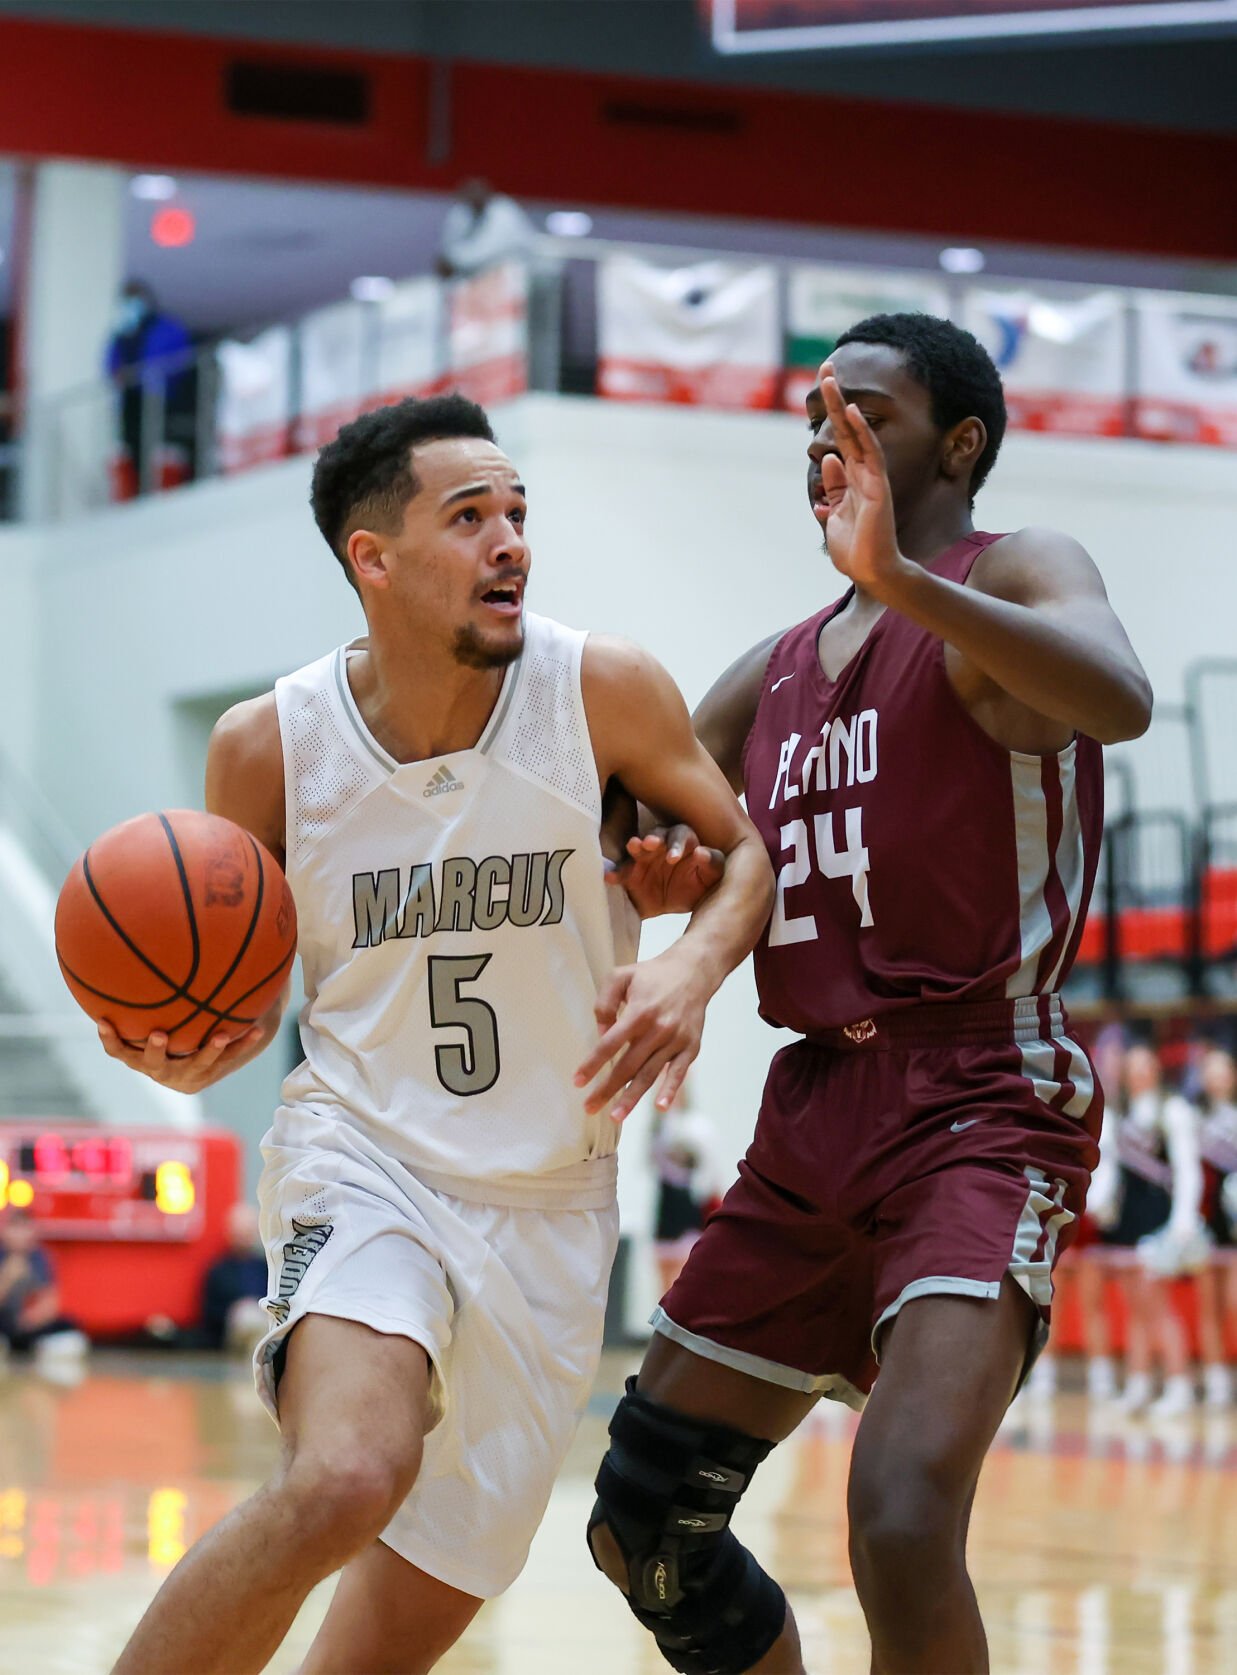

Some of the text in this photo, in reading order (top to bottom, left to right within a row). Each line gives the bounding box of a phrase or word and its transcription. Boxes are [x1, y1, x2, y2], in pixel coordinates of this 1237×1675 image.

[422, 781, 465, 798] adidas
[768, 708, 878, 810] PLANO
[351, 849, 576, 949] MARCUS
[768, 806, 875, 947] 24
[427, 953, 501, 1097] 5
